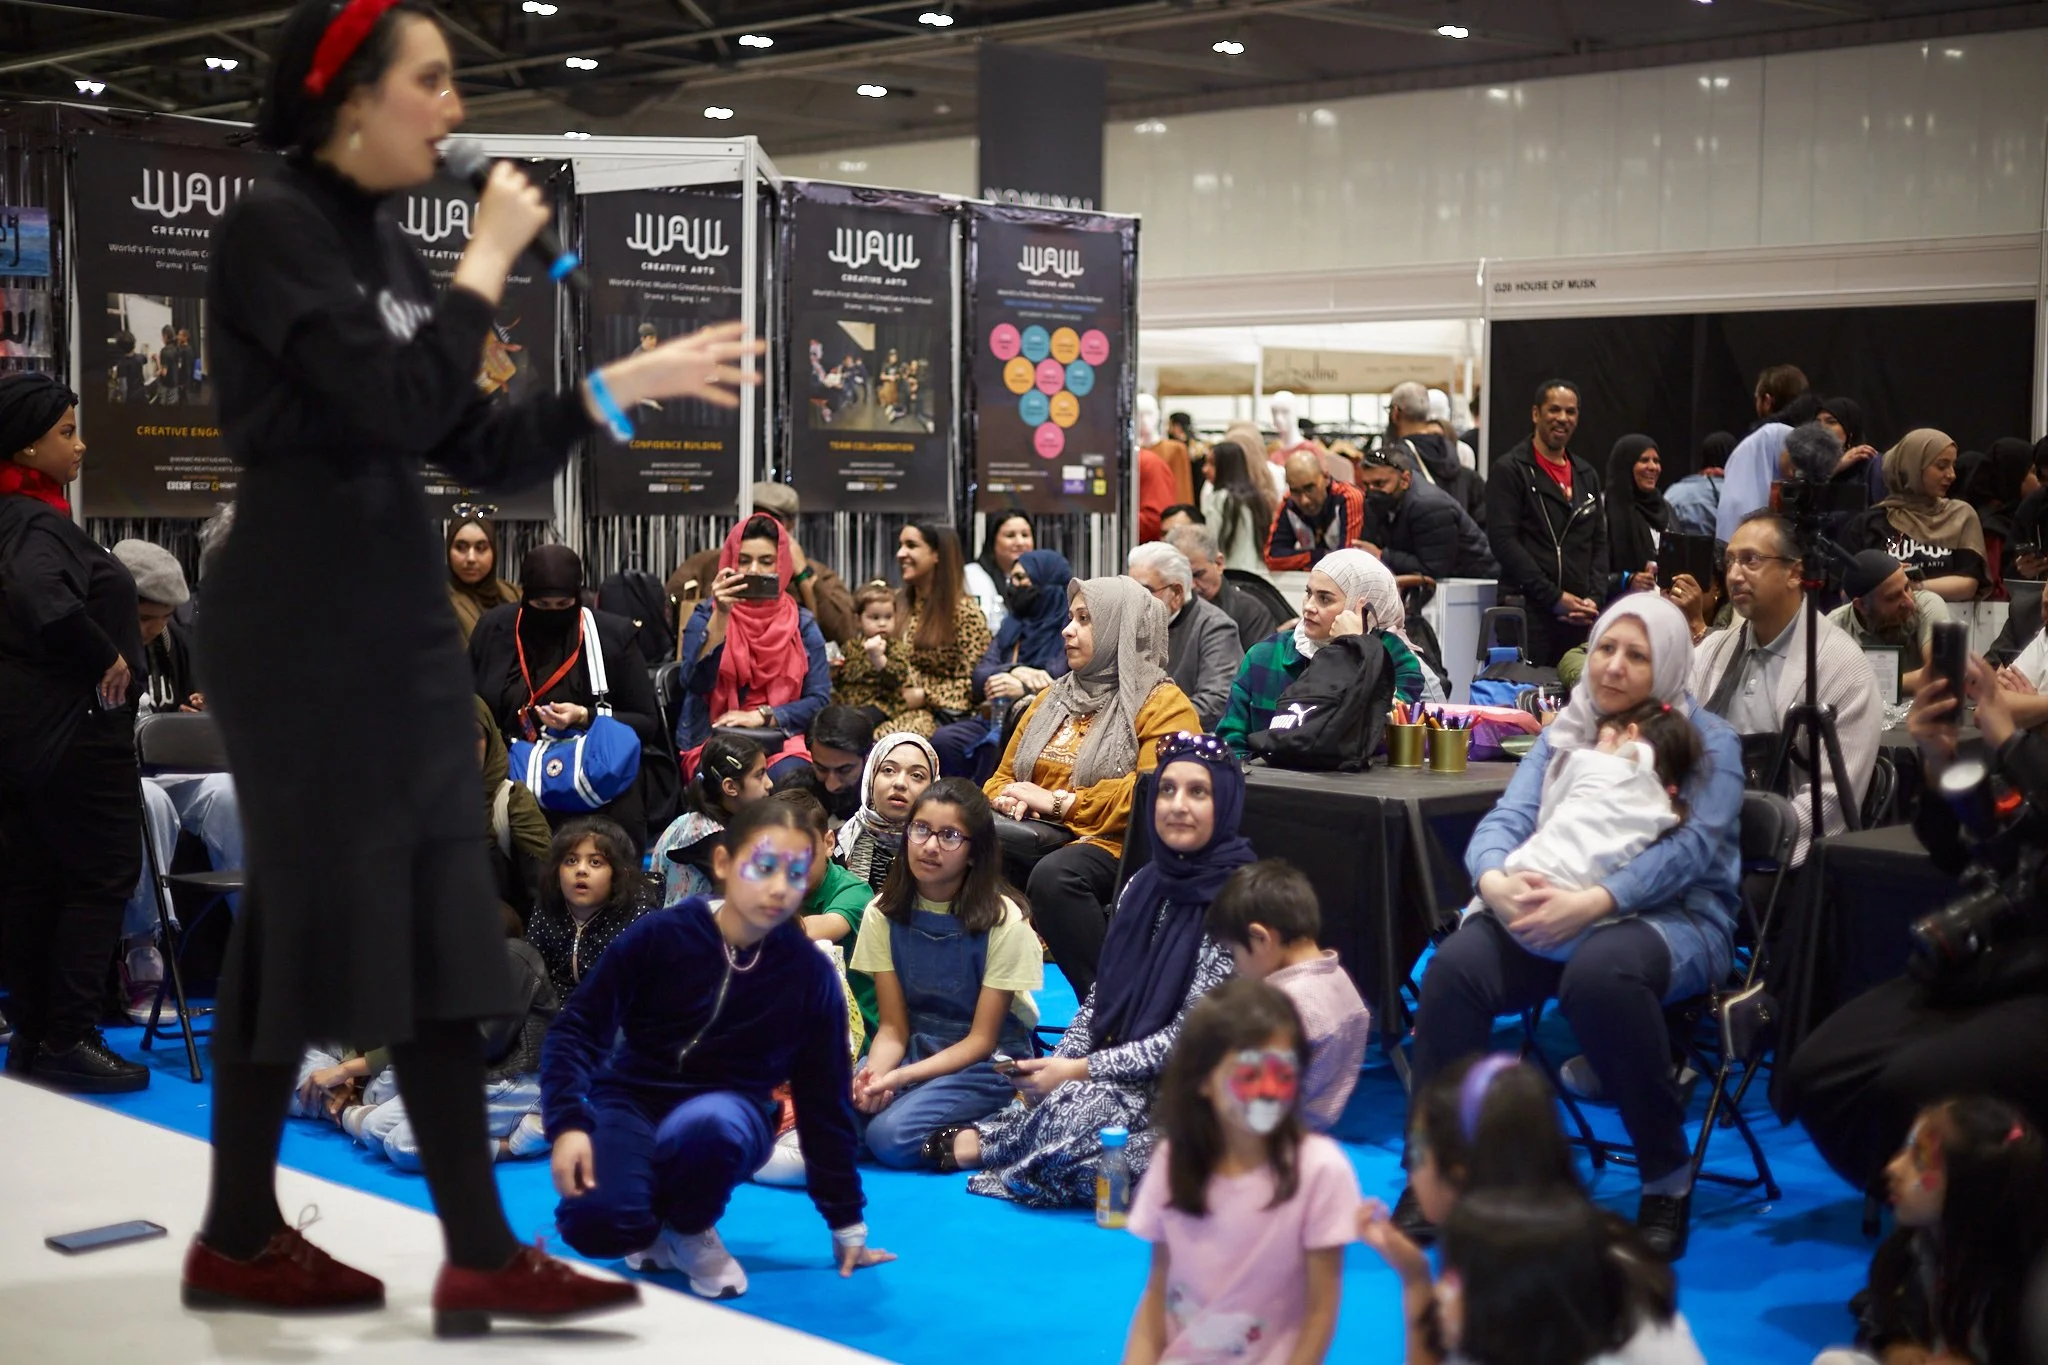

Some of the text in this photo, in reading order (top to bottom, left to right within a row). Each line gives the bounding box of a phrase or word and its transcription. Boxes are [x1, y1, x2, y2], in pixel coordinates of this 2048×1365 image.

[398, 196, 480, 242] WA
[151, 225, 210, 238] CREATIVE
[626, 212, 729, 260] WAW
[108, 243, 144, 253] World's
[145, 245, 166, 255] First
[168, 247, 199, 258] Muslim
[418, 248, 465, 261] REATIVE
[828, 227, 921, 272] WAW
[155, 260, 182, 269] Drama
[641, 262, 715, 275] CREATIVE ARTS
[1017, 245, 1084, 279] WAW
[1516, 281, 1548, 291] HOUSE
[1552, 280, 1564, 290] OF
[1568, 279, 1596, 289] MUSK
[136, 425, 187, 437] CREATIVE
